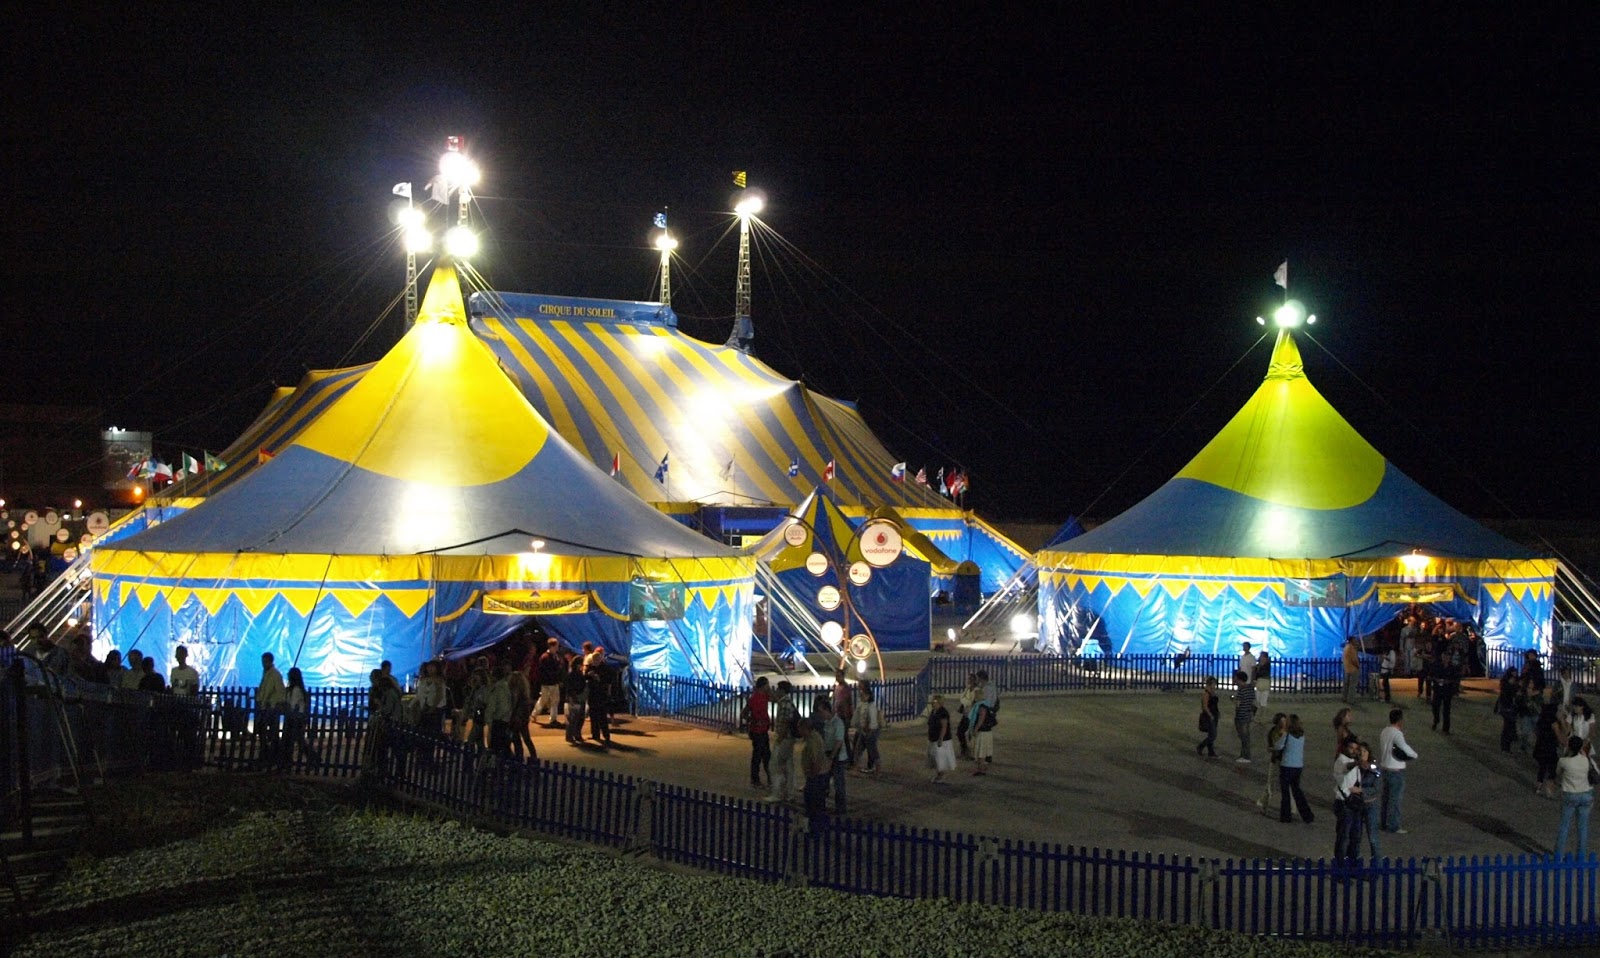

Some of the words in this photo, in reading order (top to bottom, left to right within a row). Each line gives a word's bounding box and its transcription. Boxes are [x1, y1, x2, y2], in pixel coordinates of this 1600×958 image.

[539, 304, 572, 316] CIRQUE
[573, 306, 586, 316] DU
[587, 307, 616, 318] SOLEIL
[487, 600, 540, 609] SECCIONES
